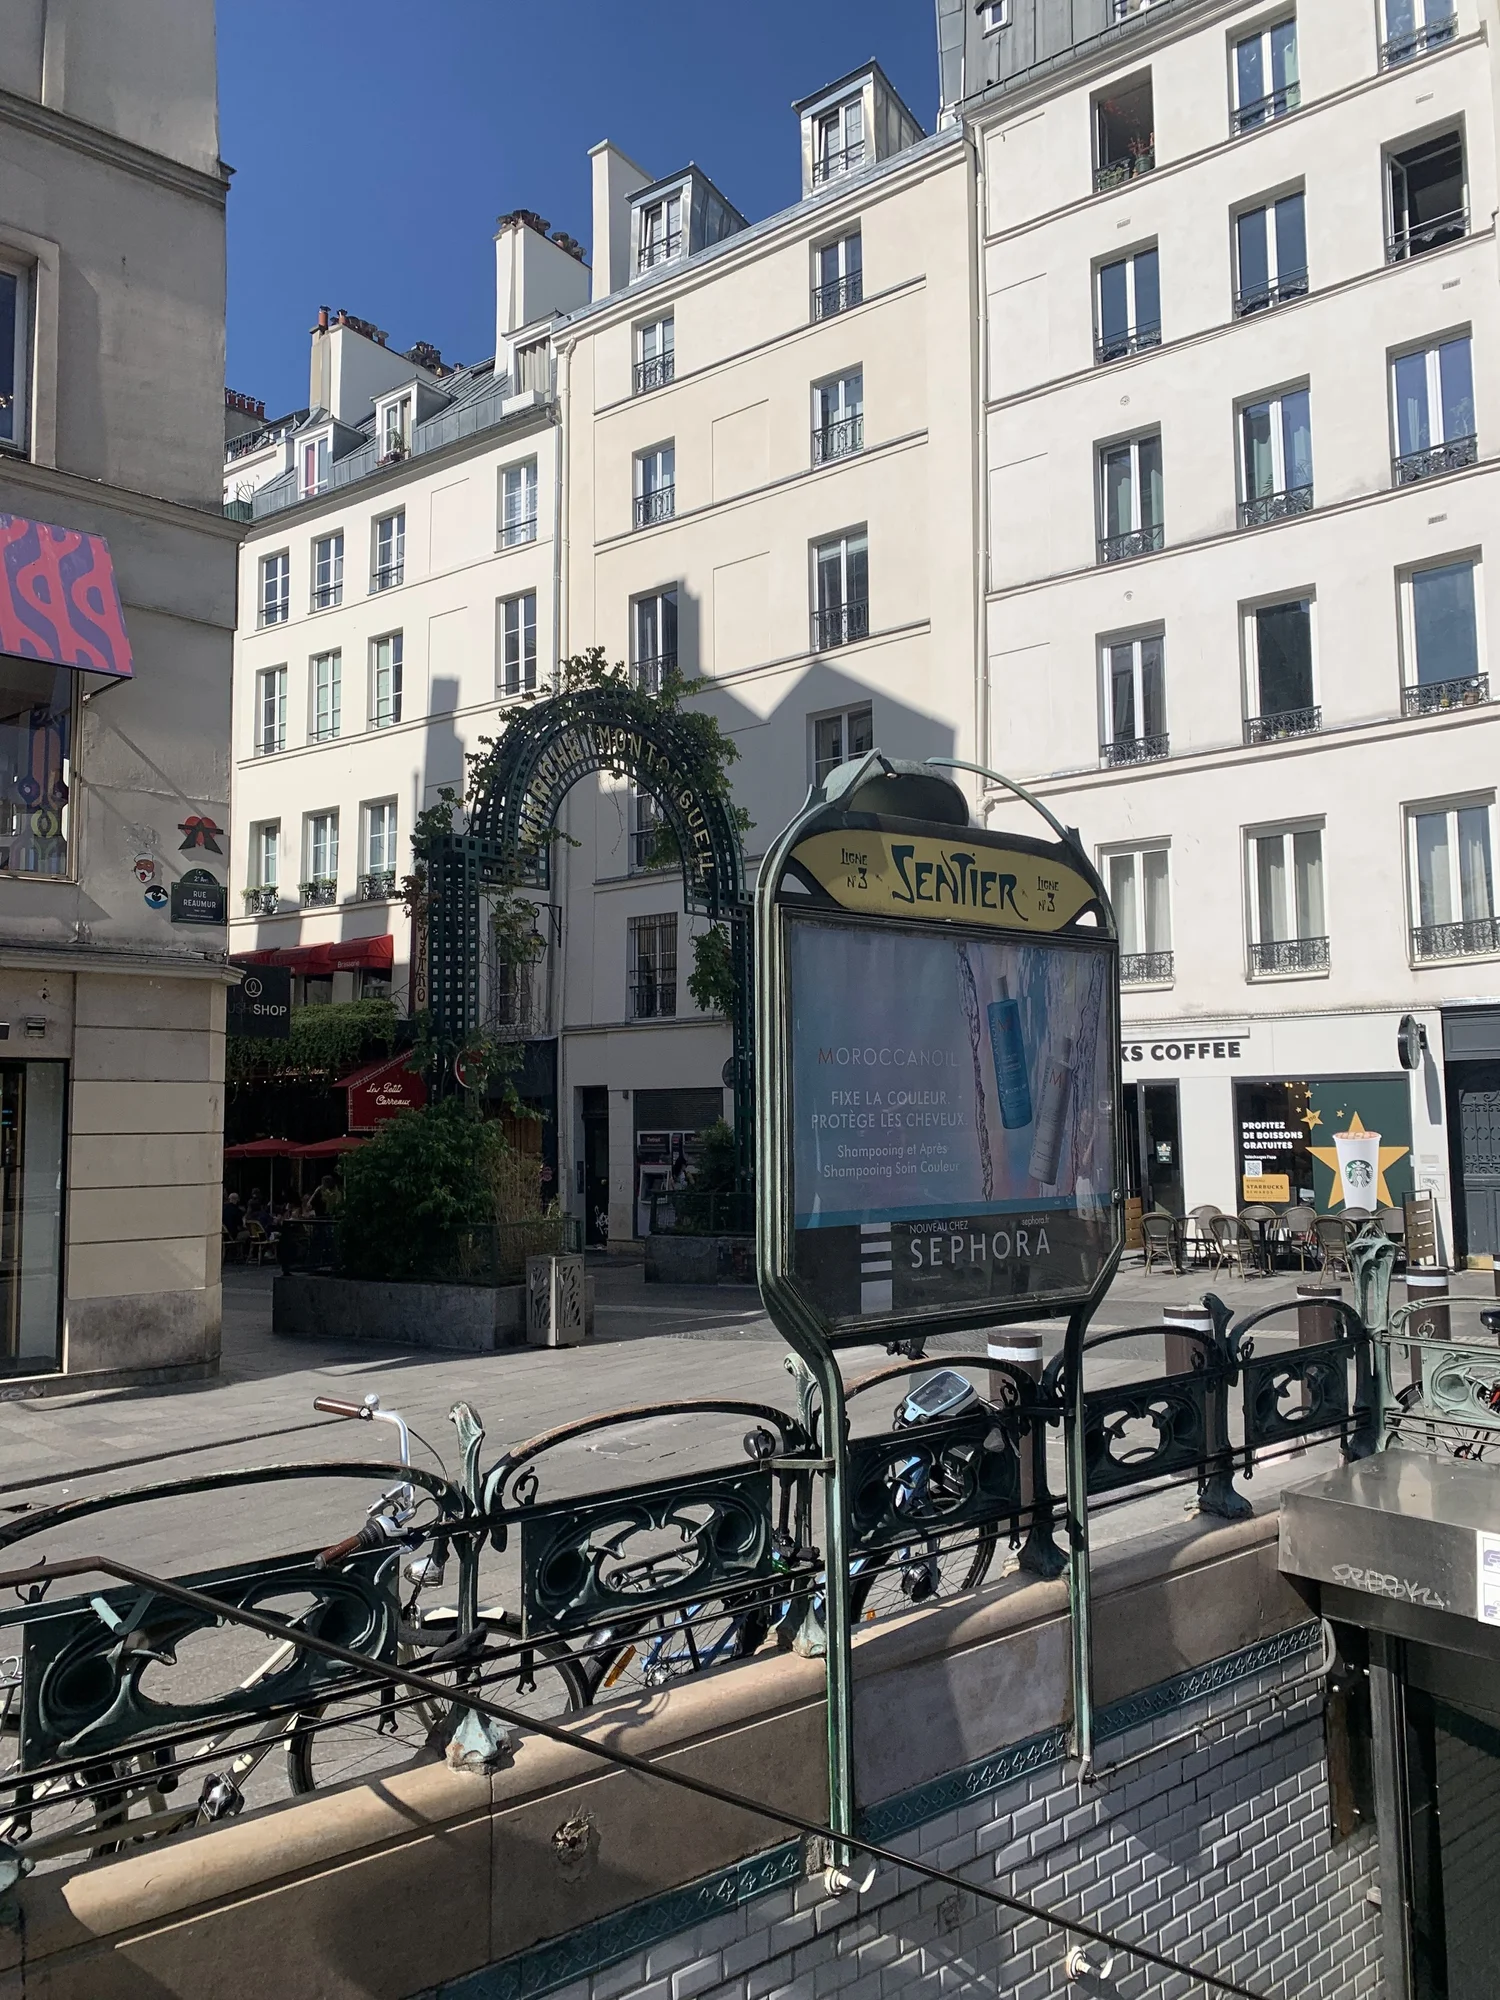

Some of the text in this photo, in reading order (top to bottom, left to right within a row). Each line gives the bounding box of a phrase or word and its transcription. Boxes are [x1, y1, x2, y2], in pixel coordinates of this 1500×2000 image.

[891, 844, 1029, 921] SENTIER
[193, 891, 207, 899] RUE
[253, 1004, 287, 1016] SHOP
[1151, 1041, 1241, 1061] COFFEE
[375, 1094, 412, 1106] Carreaux
[831, 1091, 860, 1106] FIXE
[866, 1091, 882, 1105] LA
[811, 1110, 875, 1129] PROTÈGE
[881, 1113, 902, 1128] LES
[1242, 1121, 1286, 1130] PROFITEZ
[1256, 1131, 1304, 1139] BOISSONS
[837, 1142, 948, 1160] Shampooing et Après
[1243, 1141, 1293, 1150] GRATUITES
[823, 1160, 960, 1180] Shampooing Soin Couleur
[909, 1220, 969, 1234] NOUVEAU CHEZ
[1021, 1213, 1050, 1227] sephora.fr
[910, 1228, 1051, 1268] SEPHORA
